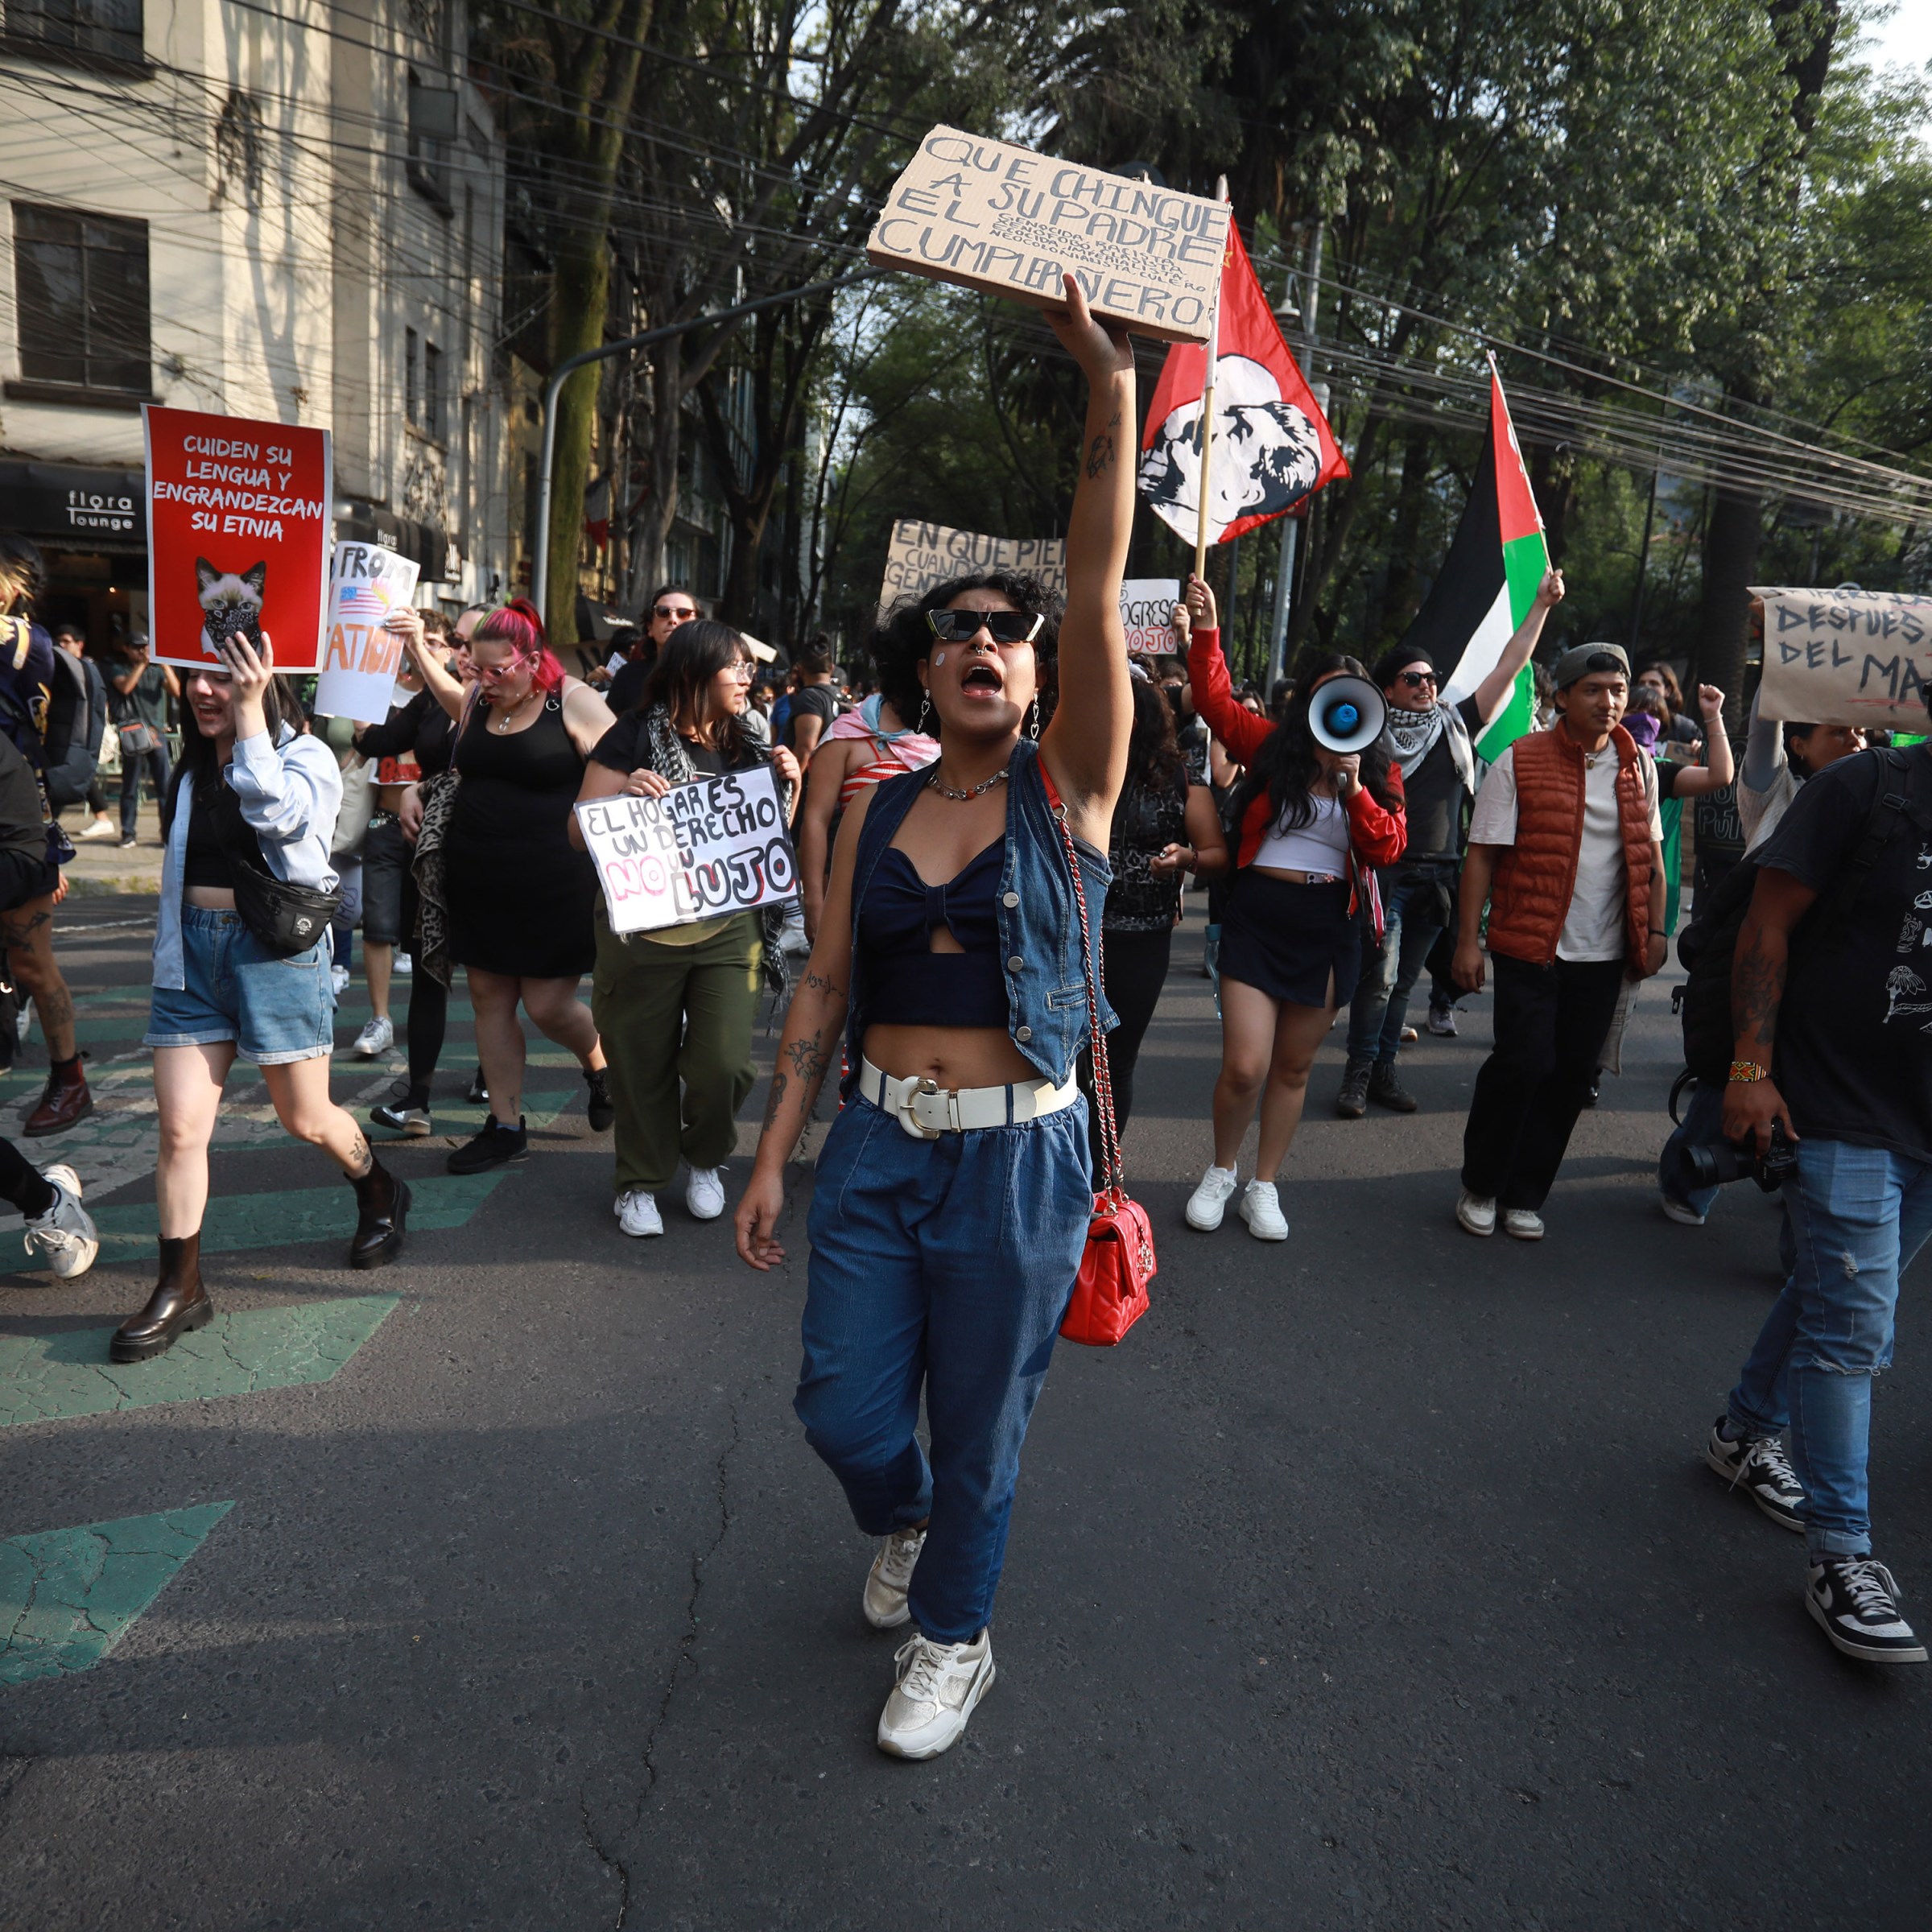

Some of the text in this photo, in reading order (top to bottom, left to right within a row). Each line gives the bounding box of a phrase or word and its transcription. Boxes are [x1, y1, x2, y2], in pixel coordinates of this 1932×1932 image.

[897, 188, 980, 229] EL
[926, 137, 1228, 239] QUE CHINGUE
[931, 172, 1225, 267] A SU PADRE
[877, 218, 1206, 325] CUMPLEAÑERO
[184, 435, 292, 467] CUIDEN SU
[186, 460, 292, 491] LENGUA Y
[68, 489, 132, 510] flora
[70, 509, 133, 531] lounge
[153, 481, 323, 520] ENGRANDEZCAN
[191, 511, 283, 542] SU ETNIA
[896, 520, 1067, 568] EN QUE PIE
[339, 547, 413, 592] FROM
[1776, 605, 1925, 644] DESPUES
[323, 623, 405, 676] ATION
[1778, 639, 1853, 668] DEL
[588, 775, 746, 836] EL HOGAR ES
[612, 797, 776, 857] UN DERECHO
[606, 836, 797, 916] NO LUJO
